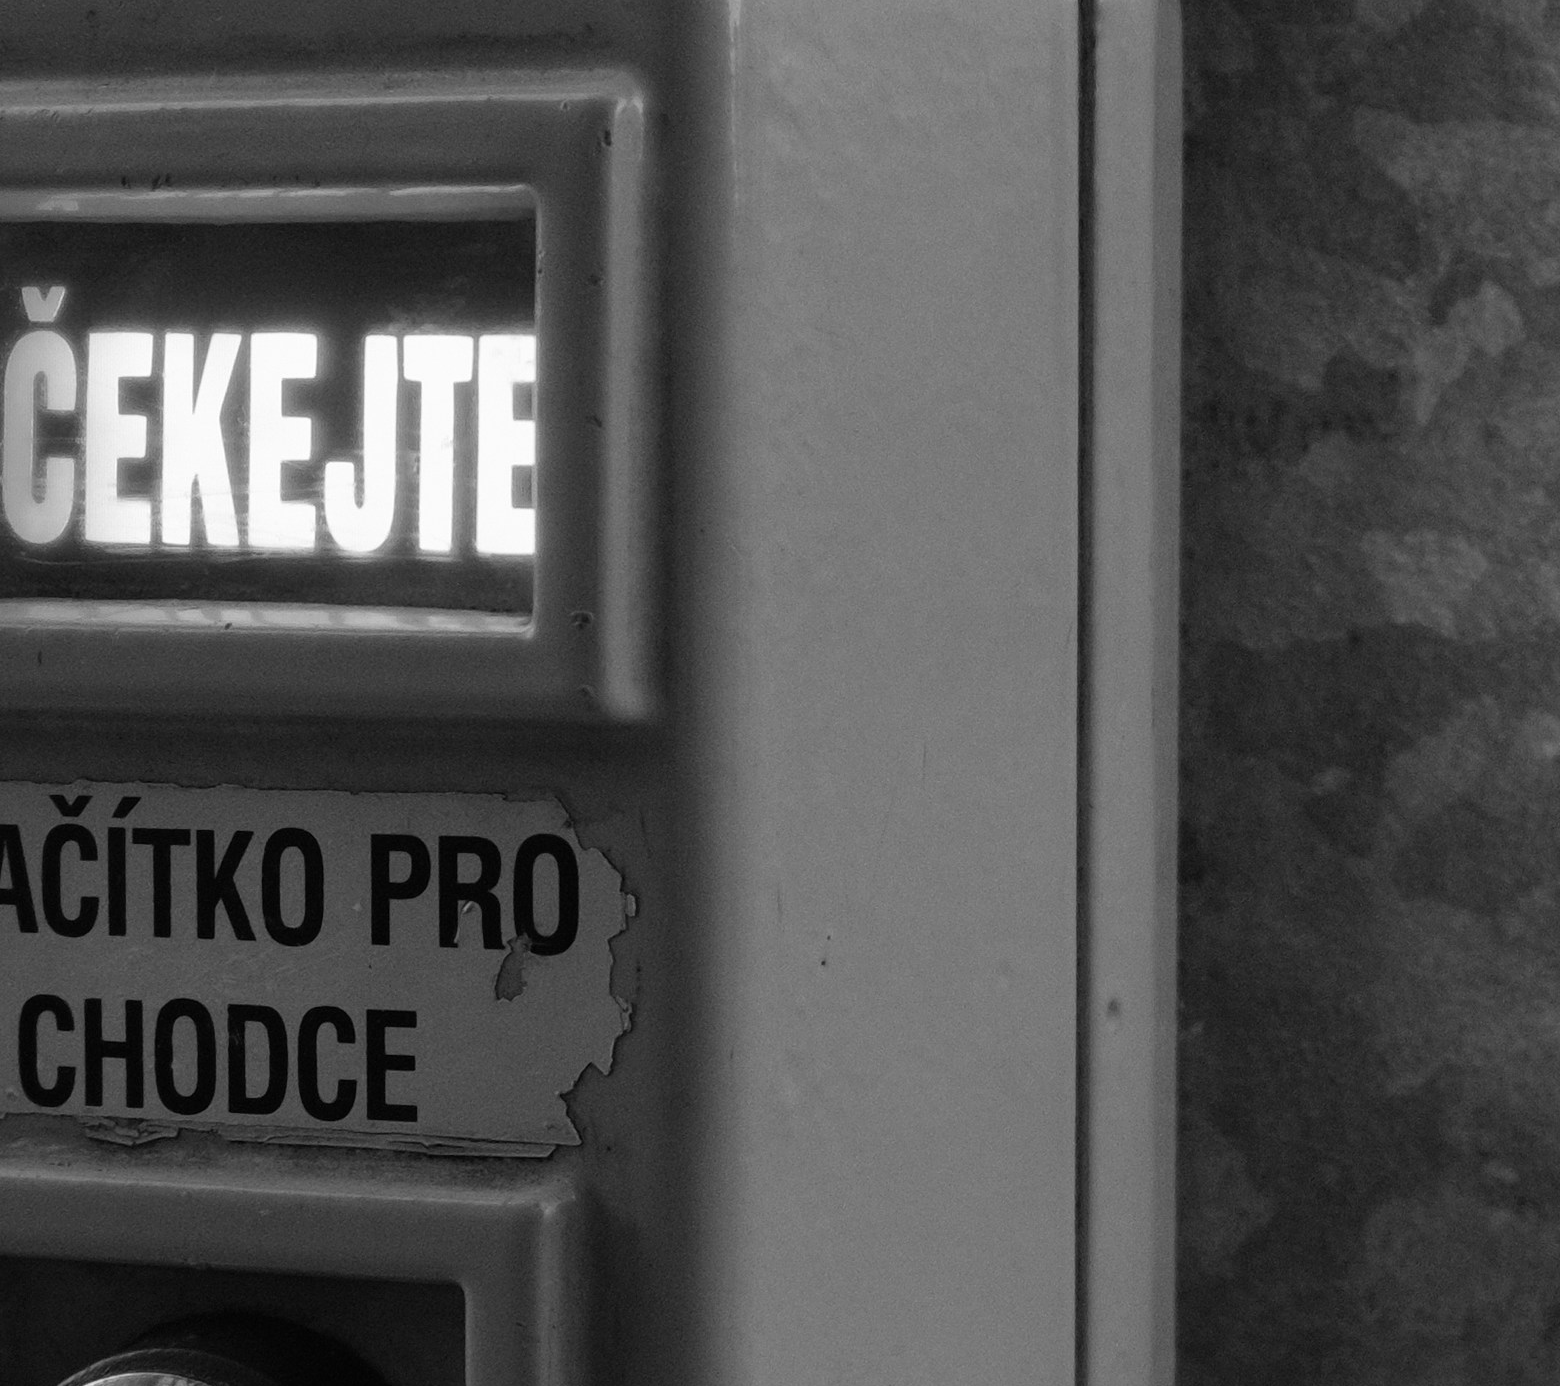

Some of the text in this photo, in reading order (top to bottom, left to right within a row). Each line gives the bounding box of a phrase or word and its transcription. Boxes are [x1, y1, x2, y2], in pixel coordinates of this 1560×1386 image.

[2, 285, 537, 556] ČEKEJTE
[369, 832, 581, 957] PRO
[17, 993, 420, 1123] CHODCE
